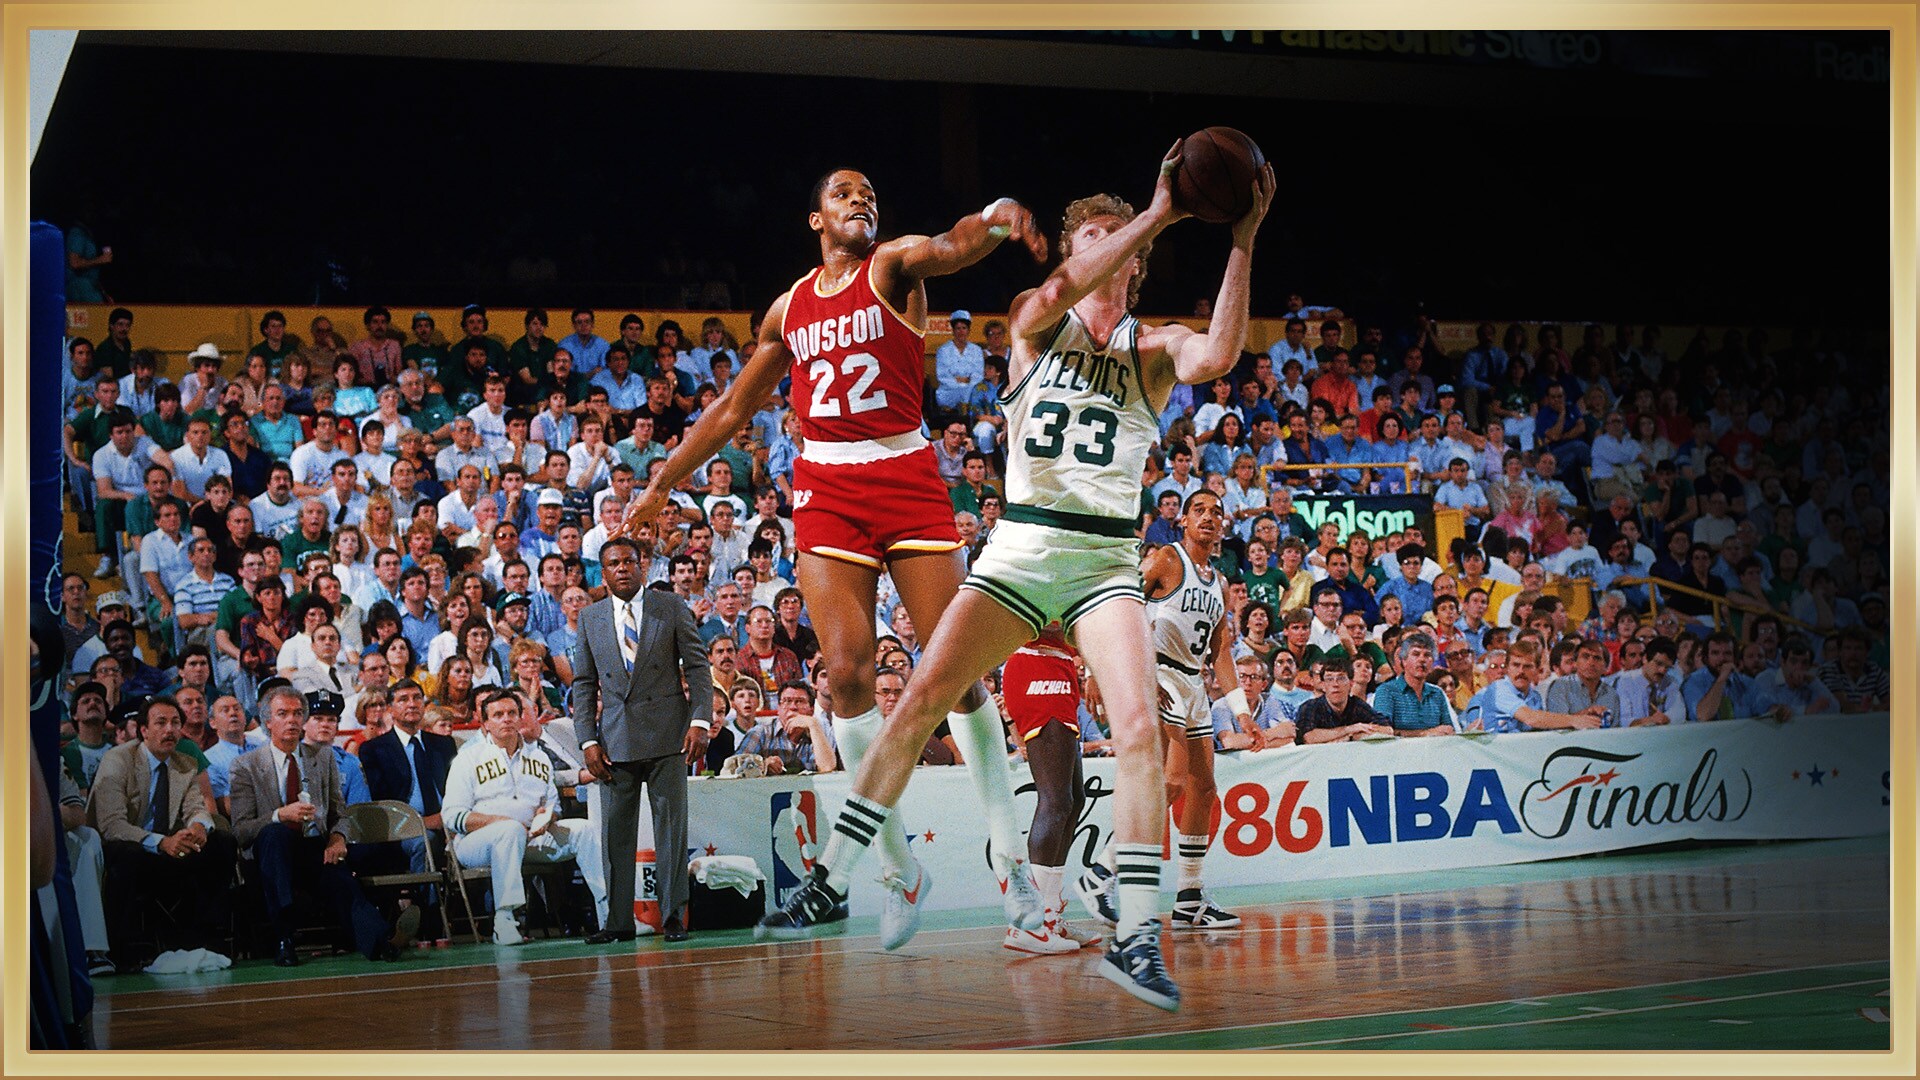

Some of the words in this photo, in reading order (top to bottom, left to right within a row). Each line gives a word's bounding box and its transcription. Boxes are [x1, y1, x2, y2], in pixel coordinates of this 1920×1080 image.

[1813, 41, 1890, 82] Radi
[809, 352, 888, 418] 22
[1039, 351, 1129, 408] CELTICS
[1024, 400, 1119, 467] 33
[1327, 768, 1522, 848] NBA
[1519, 746, 1753, 840] Finals
